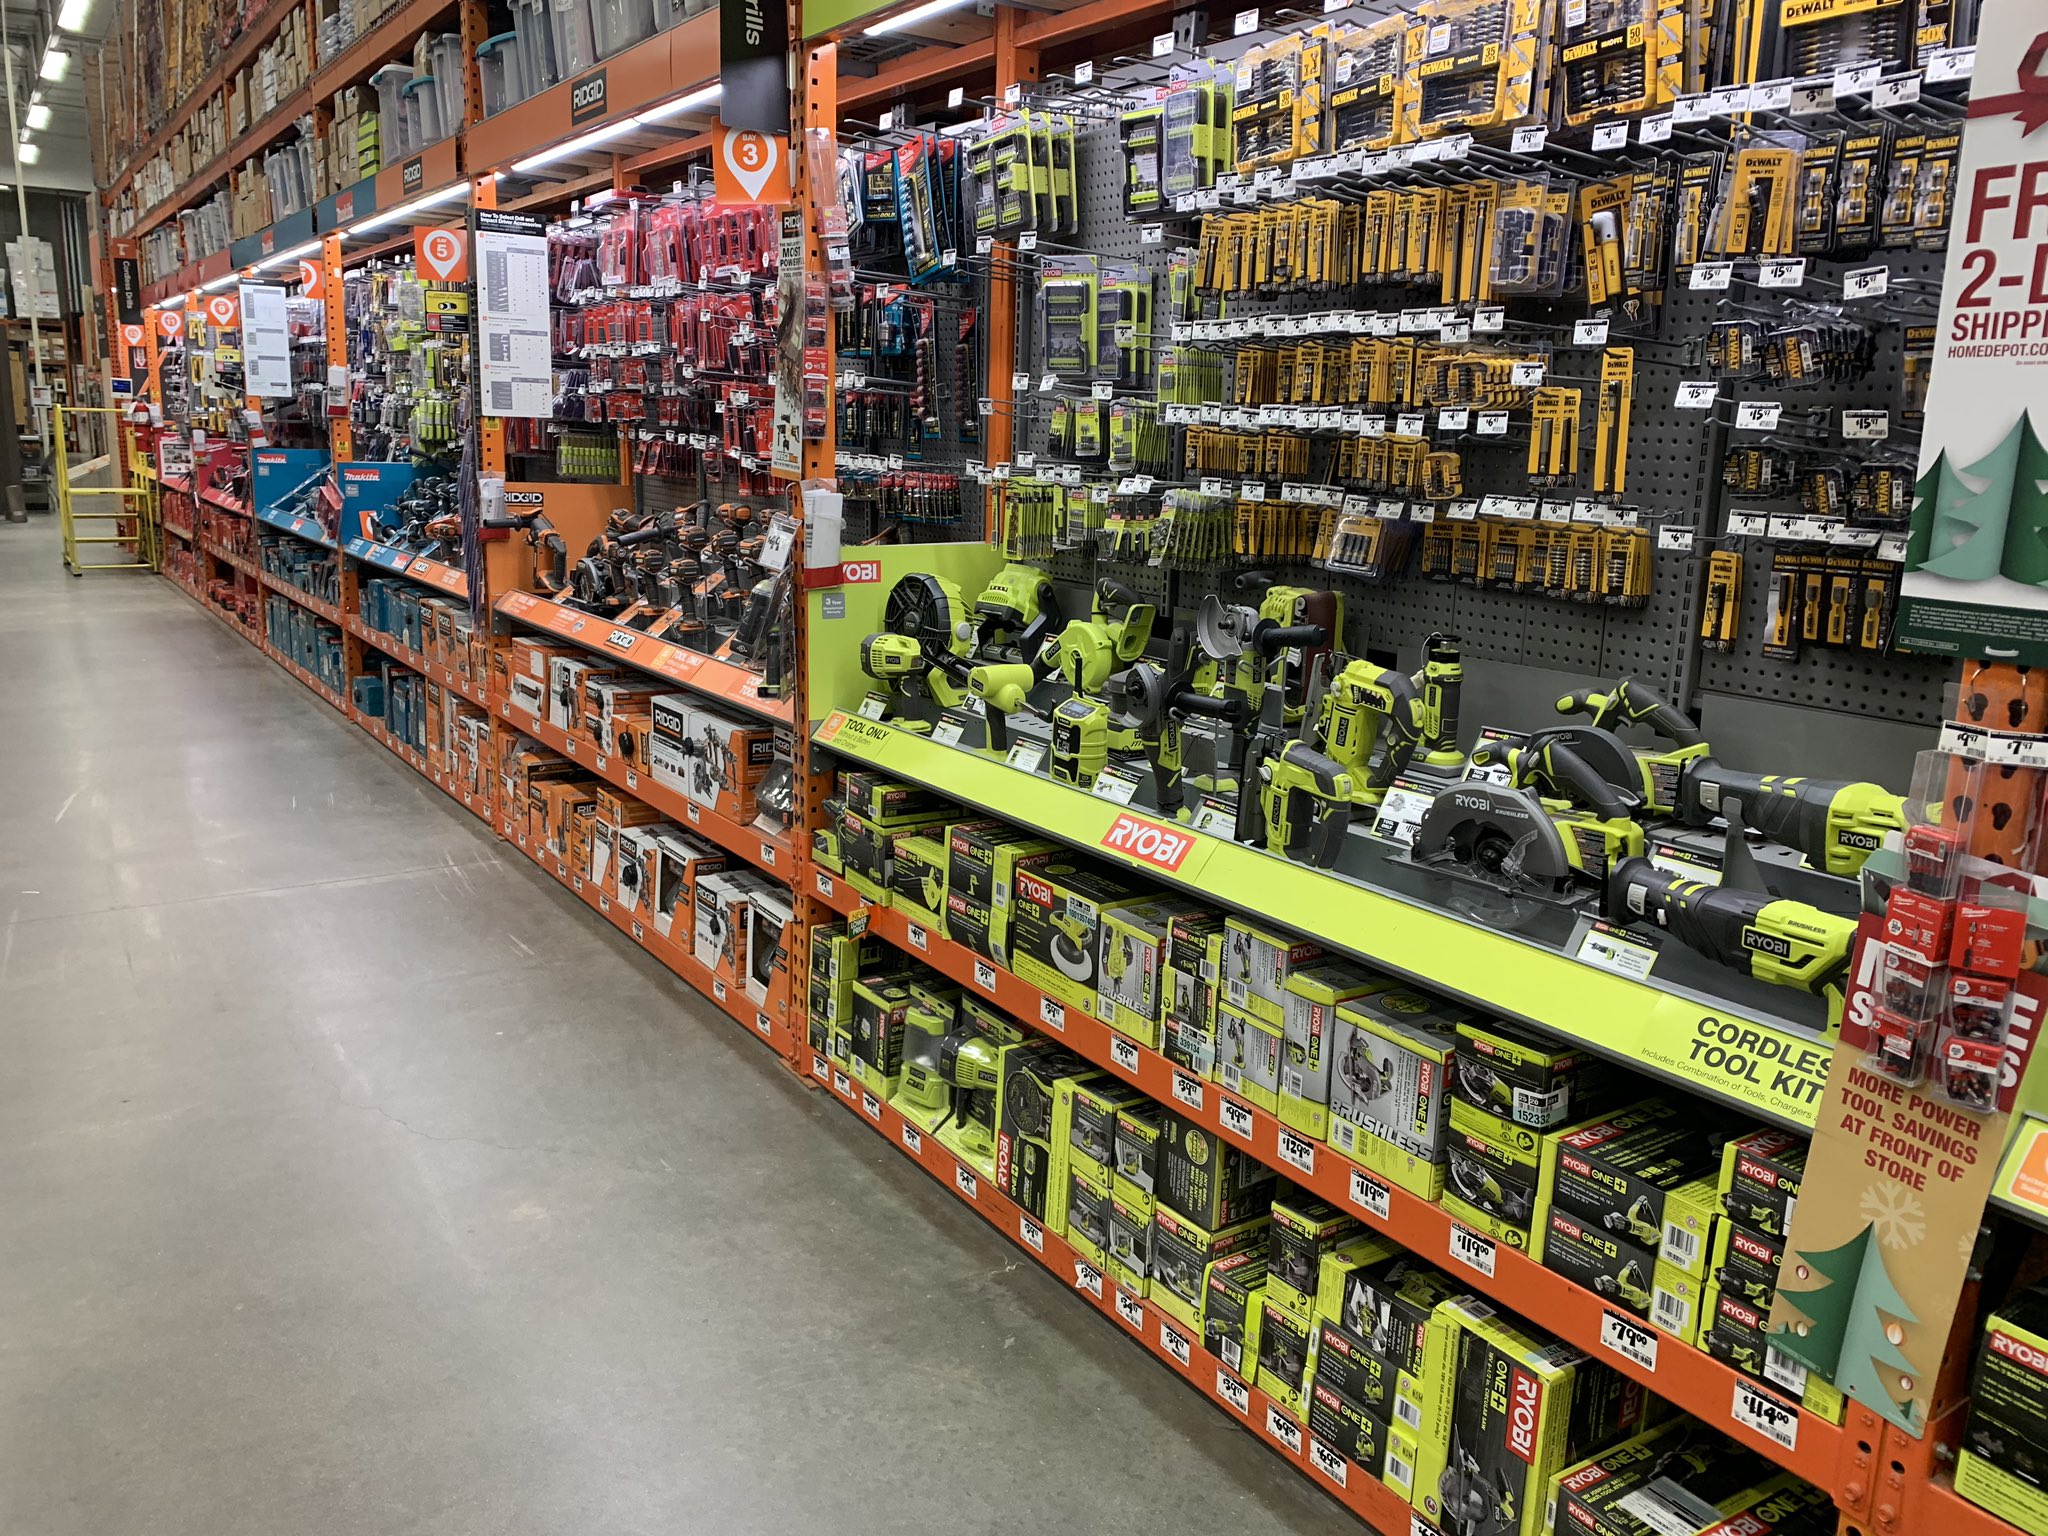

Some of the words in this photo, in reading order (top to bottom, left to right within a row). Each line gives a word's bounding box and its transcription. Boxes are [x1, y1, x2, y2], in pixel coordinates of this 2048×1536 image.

[1563, 41, 1598, 61] DEWALT
[1630, 27, 1641, 38] 50
[1916, 25, 1947, 44] 50X
[1420, 58, 1454, 76] DEWALT
[1486, 47, 1496, 58] 35
[573, 78, 604, 109] RIDGID
[1332, 89, 1358, 106] DEWALT
[1382, 77, 1390, 86] 35
[1232, 105, 1258, 121] DEWALT
[1281, 92, 1290, 101] 30
[1805, 146, 1837, 158] DEWALT
[1846, 136, 1880, 149] DEWALT
[1926, 136, 1960, 149] DEWALT
[743, 143, 759, 166] 3
[1746, 157, 1782, 167] DEWALT
[404, 163, 421, 185] RIDGID
[1684, 166, 1712, 178] DEWALT
[1591, 190, 1626, 209] DEWALT
[436, 244, 448, 258] 5
[782, 246, 800, 258] MOST
[122, 261, 131, 290] Cordless
[218, 306, 226, 314] 9
[166, 318, 176, 326] 11
[1728, 328, 1740, 370] DEWALT
[1785, 336, 1801, 378] DEWALT
[1948, 343, 2048, 358] HOMEDEPOT.CO
[1749, 451, 1758, 491] DEWALT
[503, 493, 543, 504] RIDGID
[1816, 474, 1829, 515] DEWALT
[1876, 470, 1890, 514] DEWALT
[842, 562, 878, 582] YOBI
[1826, 558, 1860, 568] DEWALT
[1862, 560, 1895, 571] DEWALT
[610, 631, 636, 647] RIDGID
[654, 708, 682, 734] RIDGID
[844, 718, 864, 734] TOOL
[866, 726, 890, 741] ONLY
[1337, 718, 1350, 746] RYOBI
[1168, 720, 1177, 748] RYOBI
[752, 743, 774, 754] RID
[886, 792, 907, 800] RYOBI
[1455, 794, 1490, 812] RYOBI
[1495, 809, 1530, 819] BRUSHLESS
[845, 812, 862, 832] RYOBI
[620, 836, 637, 852] RIDGID
[952, 838, 969, 851] RYOBI
[1108, 818, 1188, 866] RYOBI
[1840, 832, 1879, 849] RYOBI
[697, 862, 722, 872] RIDGID
[948, 896, 966, 911] RYOBI
[1020, 878, 1052, 906] RYOBI
[850, 918, 867, 931] LOWER
[851, 910, 866, 918] NEW
[852, 922, 866, 936] PRICE
[1788, 920, 1827, 934] BRUSHLESS
[1745, 932, 1788, 956] RYOBI
[1100, 984, 1153, 1019] BRUSHLESS
[1312, 1007, 1322, 1036] RYOBI
[1180, 1036, 1200, 1054] 339134
[1474, 1039, 1493, 1056] RYOBI
[1698, 1016, 1832, 1080] CORDLES
[1689, 1038, 1763, 1086] TOOL
[1419, 1062, 1431, 1094] RYOBI
[1642, 1047, 1676, 1066] Includes
[1676, 1058, 1731, 1087] Combination
[1732, 1082, 1742, 1091] of
[1742, 1084, 1769, 1103] Tools,
[1770, 1094, 1812, 1119] Chargers
[1848, 1066, 1904, 1106] MORE
[1908, 1094, 1981, 1141] POWER
[1518, 1110, 1551, 1125] 152332
[1841, 1088, 1885, 1123] TOOL
[1892, 1112, 1978, 1165] SAVINGS
[1330, 1098, 1433, 1162] BRUSHLESS
[1568, 1124, 1618, 1148] RYOBI
[1466, 1135, 1486, 1152] RYOBI
[1840, 1114, 1866, 1136] AT
[1870, 1126, 1933, 1168] FRONT
[1938, 1160, 1965, 1183] OF
[998, 1134, 1009, 1188] RYOBI
[1562, 1154, 1590, 1176] RYOBI
[1864, 1149, 1926, 1192] STORE
[1740, 1160, 1775, 1186] RYOBI
[1777, 1178, 1800, 1195] ON
[1156, 1212, 1177, 1234] RYOBI
[1273, 1212, 1290, 1226] RYOBI
[1554, 1216, 1582, 1240] RYOBI
[1734, 1236, 1770, 1260] RYOBI
[1218, 1254, 1248, 1272] RYOBI
[1210, 1277, 1225, 1292] RYOBI
[1266, 1306, 1282, 1322] RYOBI
[1722, 1301, 1756, 1326] RYOBI
[1324, 1330, 1350, 1354] RYOBI
[1315, 1386, 1341, 1411] RYOBI
[1490, 1360, 1508, 1415] ONE+
[1482, 1388, 1490, 1417] CIRCULAR
[1511, 1376, 1538, 1457] RYOBI
[1568, 1466, 1605, 1490] RYOBI
[1568, 1504, 1594, 1528] RYOBI
